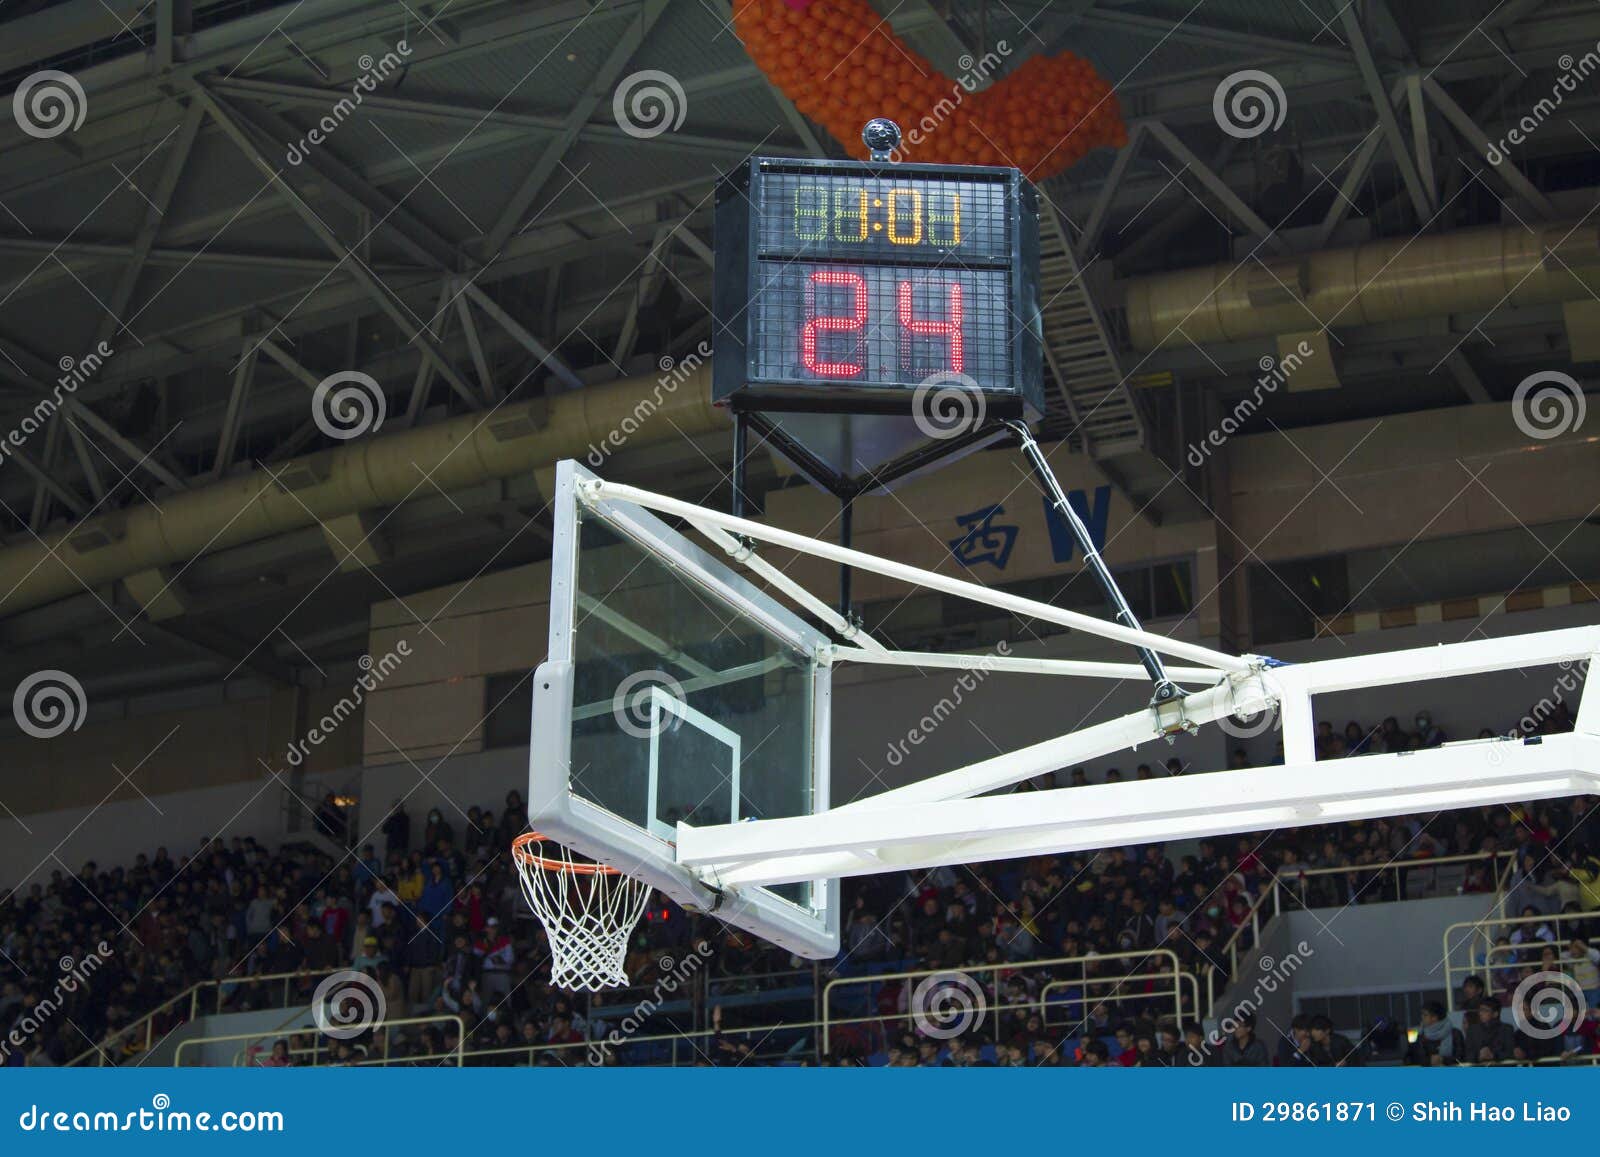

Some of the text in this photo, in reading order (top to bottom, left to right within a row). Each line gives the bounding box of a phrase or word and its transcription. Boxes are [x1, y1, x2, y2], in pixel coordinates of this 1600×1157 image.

[803, 271, 963, 376] 24
[948, 485, 1112, 570] 西 W
